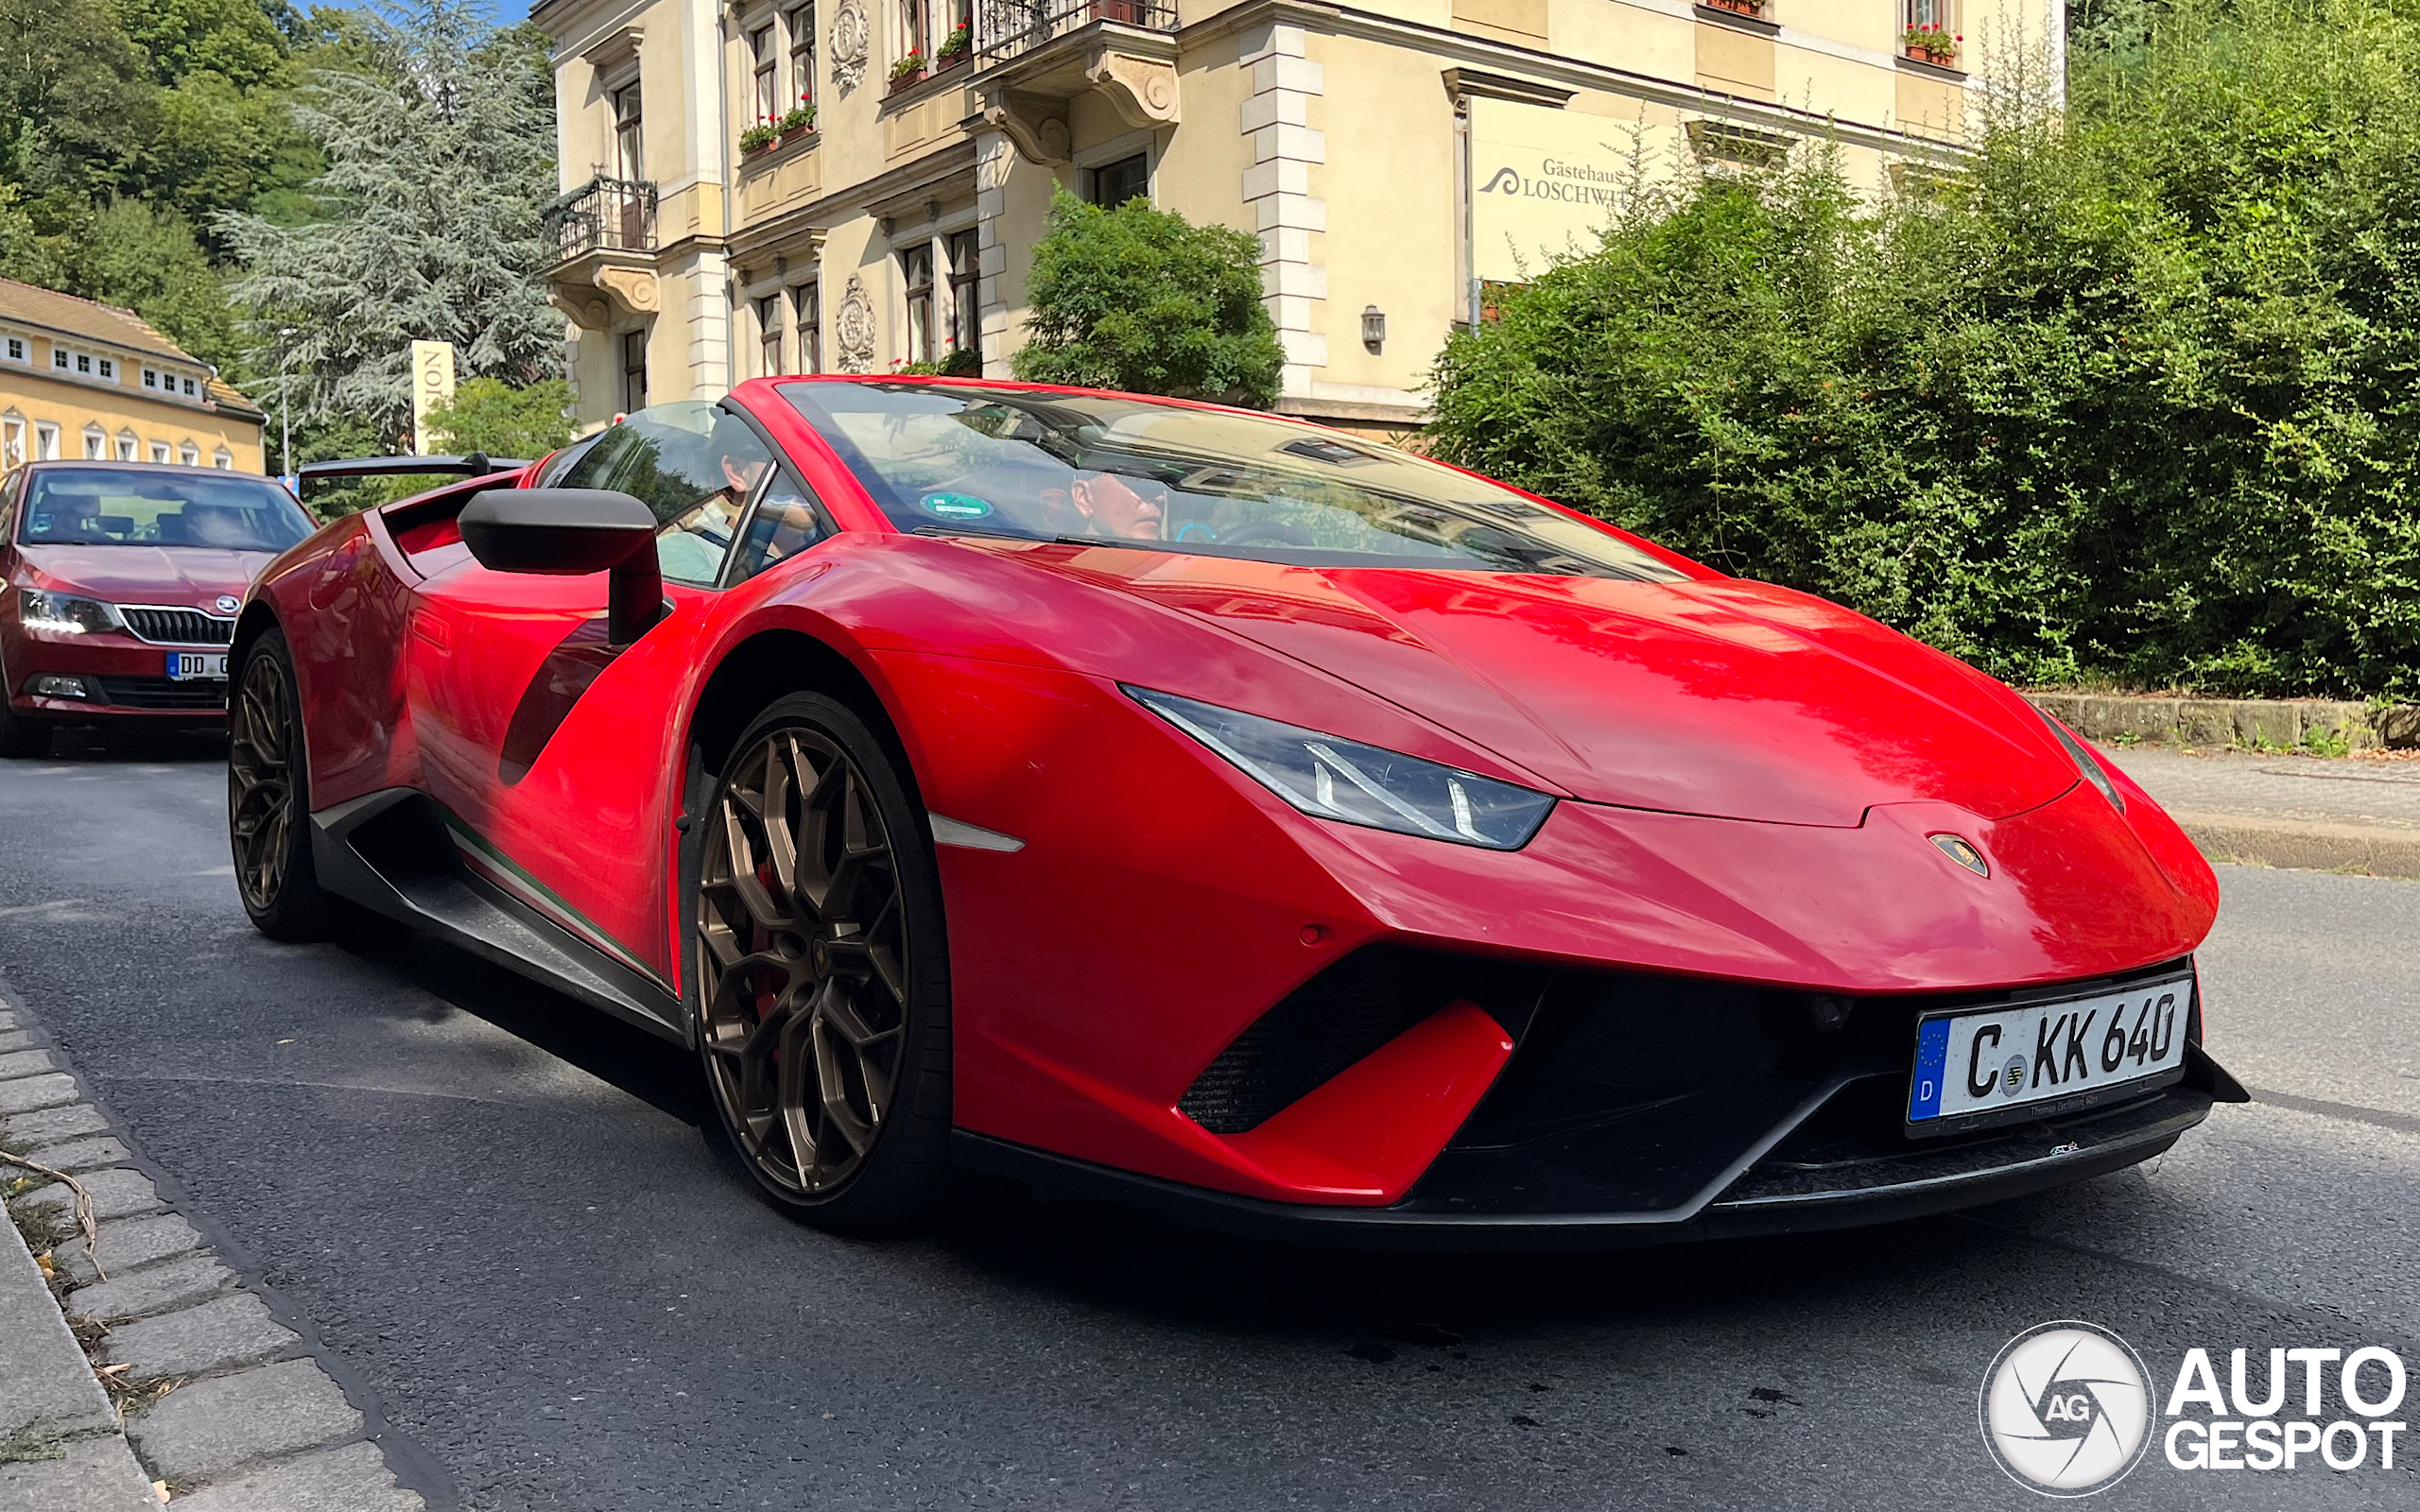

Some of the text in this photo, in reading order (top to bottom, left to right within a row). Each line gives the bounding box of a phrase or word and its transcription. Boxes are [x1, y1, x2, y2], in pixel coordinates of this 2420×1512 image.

[1543, 158, 1622, 185] Gästehaus
[1523, 179, 1628, 208] LOSCHWIT
[424, 349, 442, 408] SION
[182, 656, 204, 674] DD
[1967, 993, 2175, 1098] C KK 640
[1920, 1080, 1933, 1102] D
